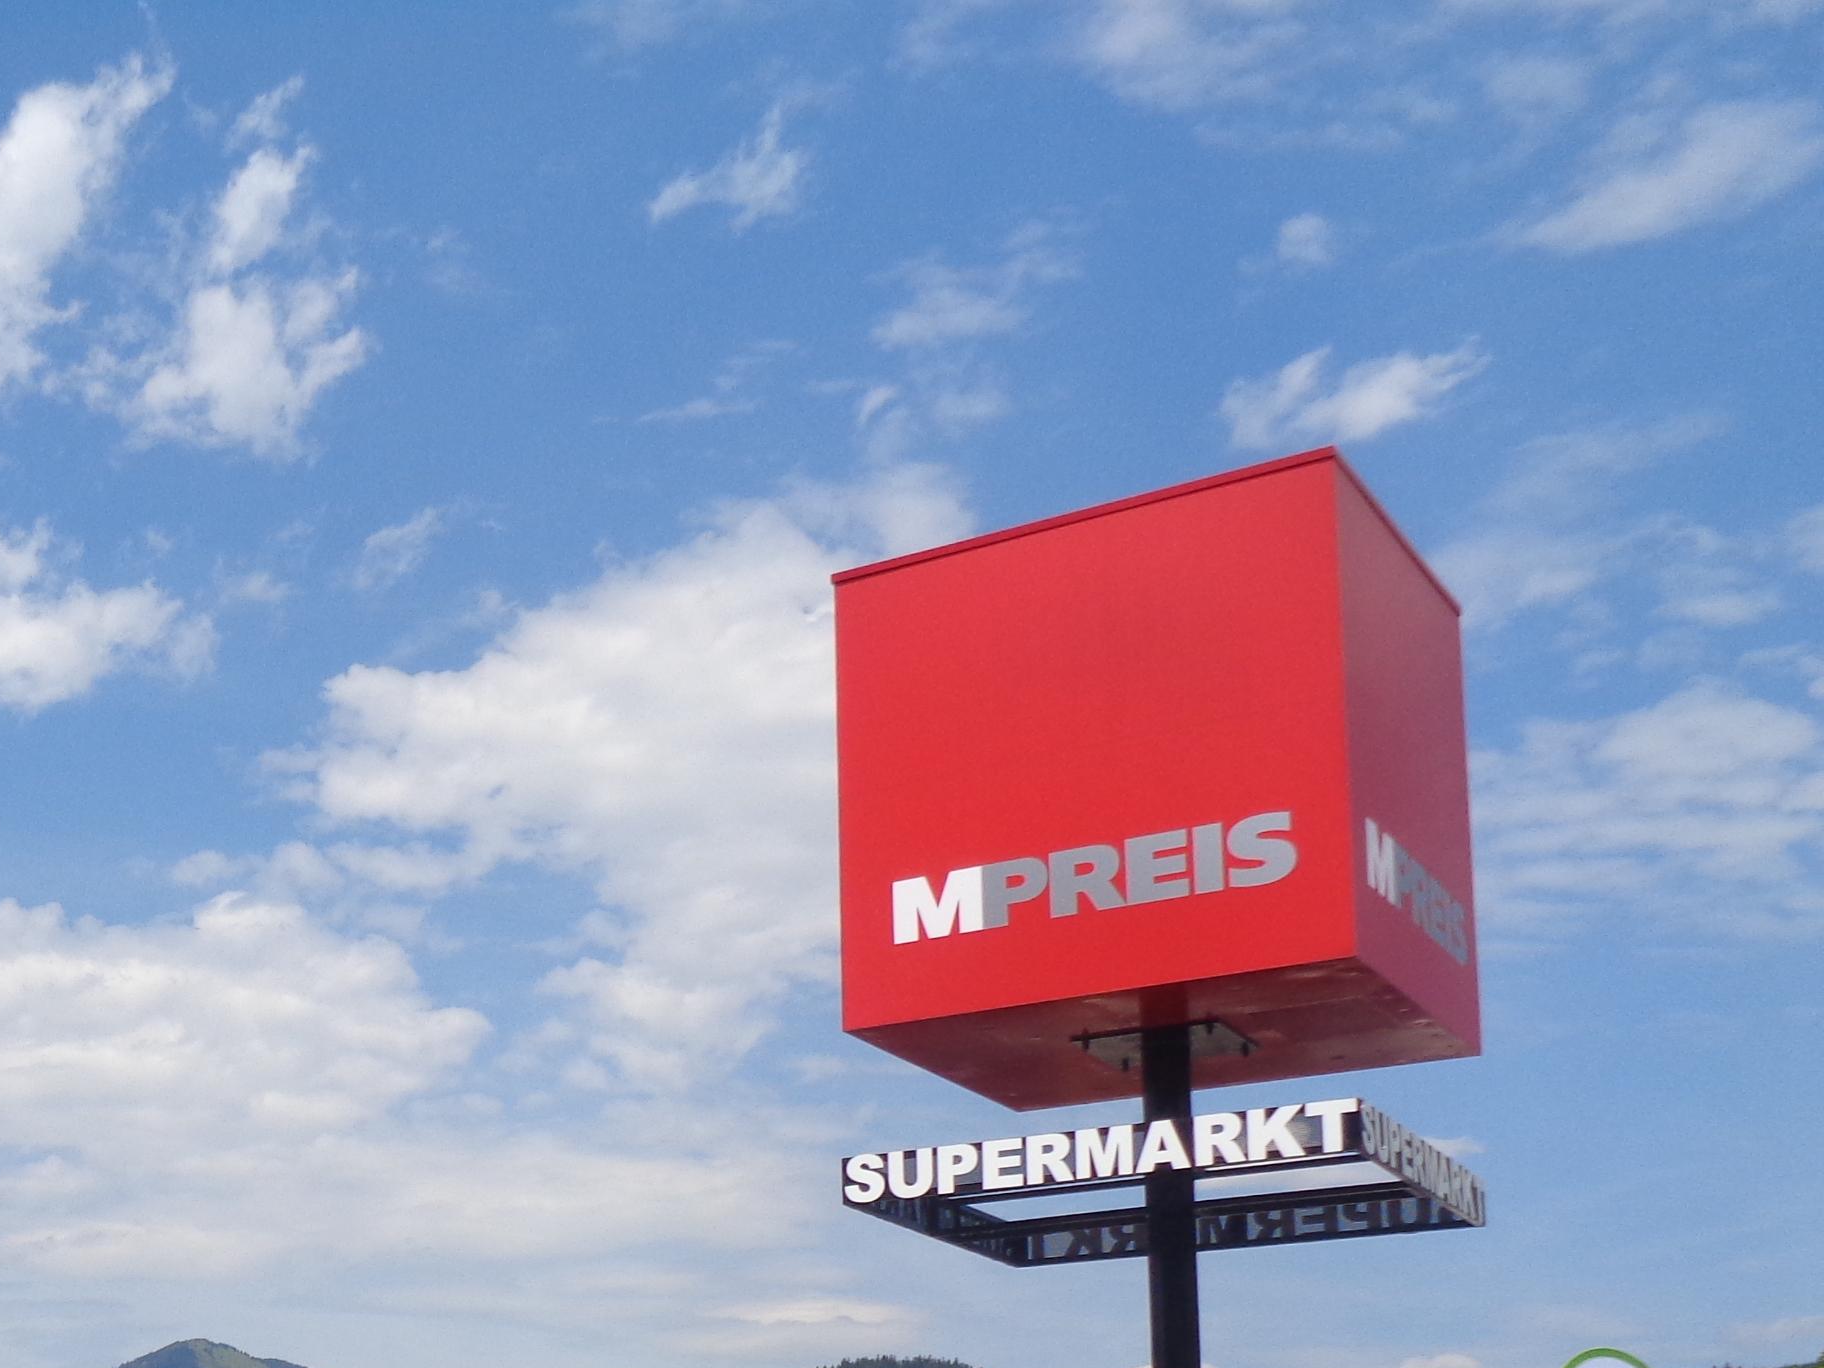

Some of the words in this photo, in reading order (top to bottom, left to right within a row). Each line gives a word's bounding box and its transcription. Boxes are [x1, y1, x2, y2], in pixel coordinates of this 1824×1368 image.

[892, 812, 1299, 945] MPREIS
[1365, 817, 1469, 966] MPREIS
[843, 1099, 1357, 1204] SUPERMARKT
[1361, 1103, 1484, 1227] SUPERMARKT
